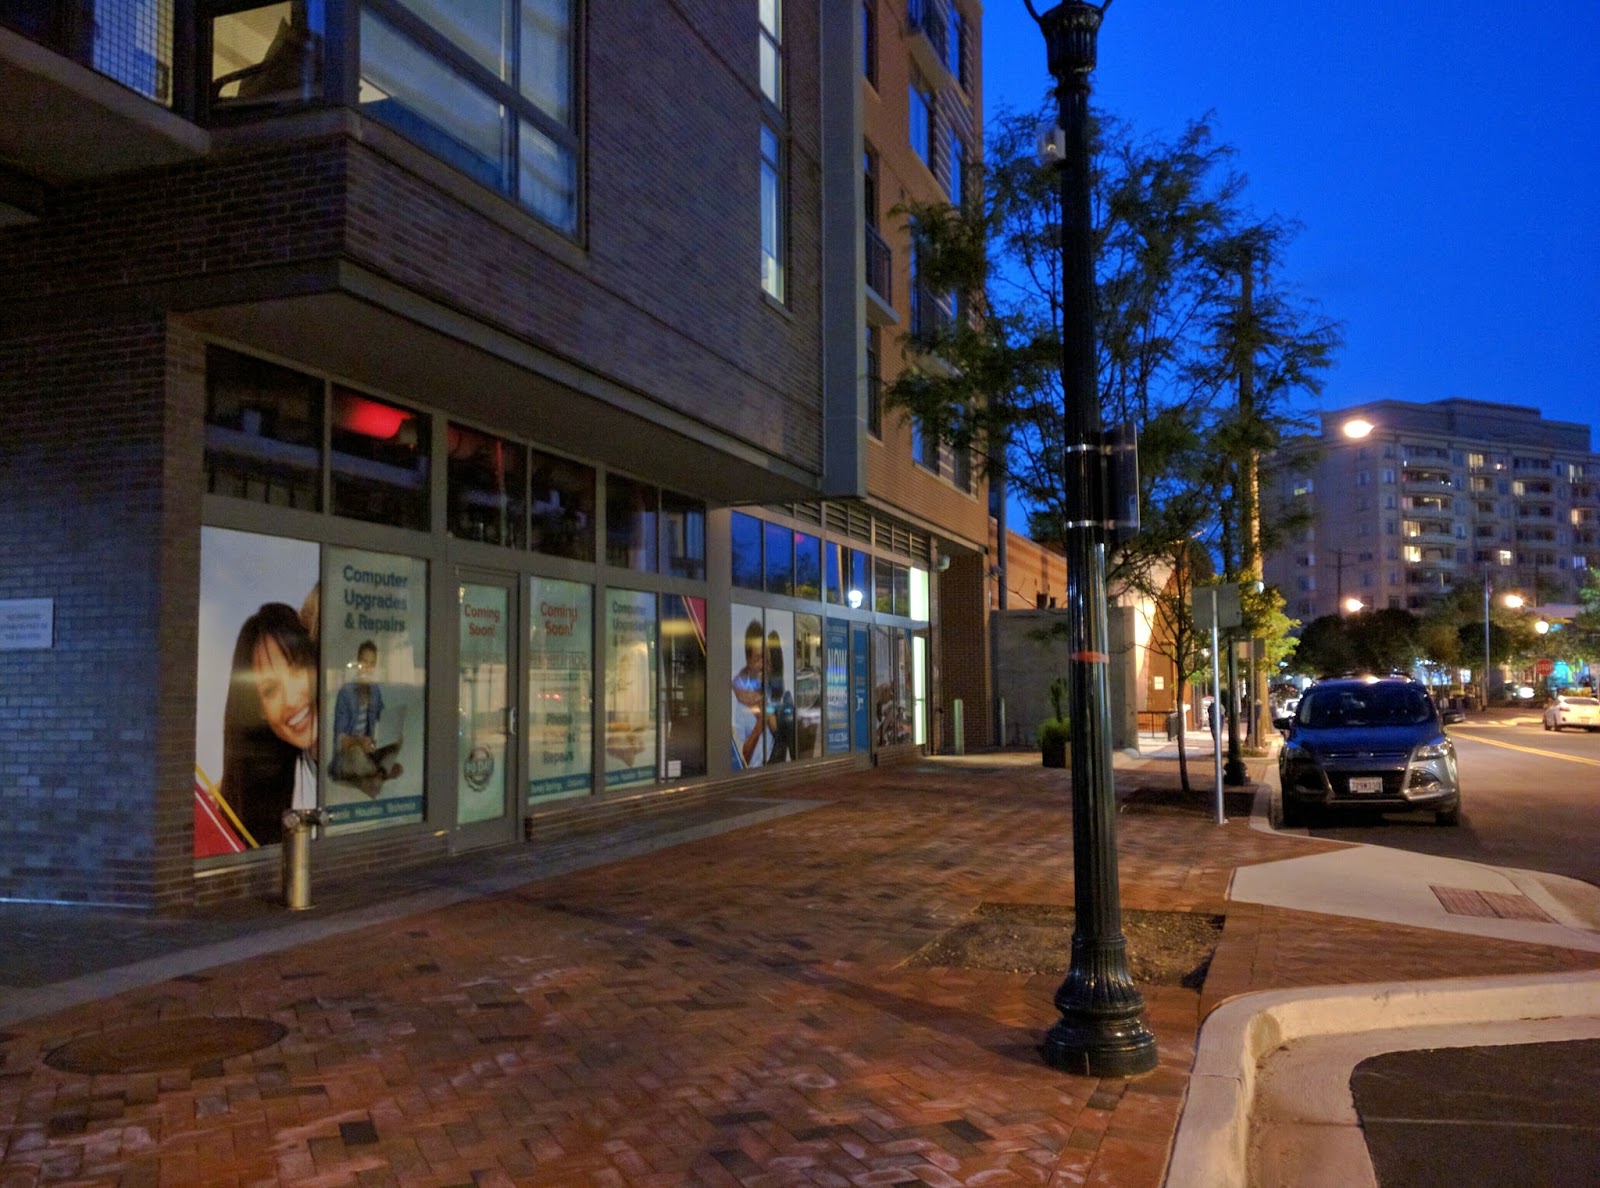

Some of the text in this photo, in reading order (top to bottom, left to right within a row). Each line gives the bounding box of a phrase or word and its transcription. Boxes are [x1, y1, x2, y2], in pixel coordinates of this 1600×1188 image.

[343, 564, 408, 588] Computer
[344, 588, 407, 611] Upgrades
[612, 600, 647, 616] Compu
[344, 612, 405, 634] & Repairs
[464, 604, 500, 622] Coming
[540, 601, 578, 623] Coming
[469, 622, 496, 637] Soon!
[544, 620, 573, 636] Soon!
[827, 648, 848, 684] NOW
